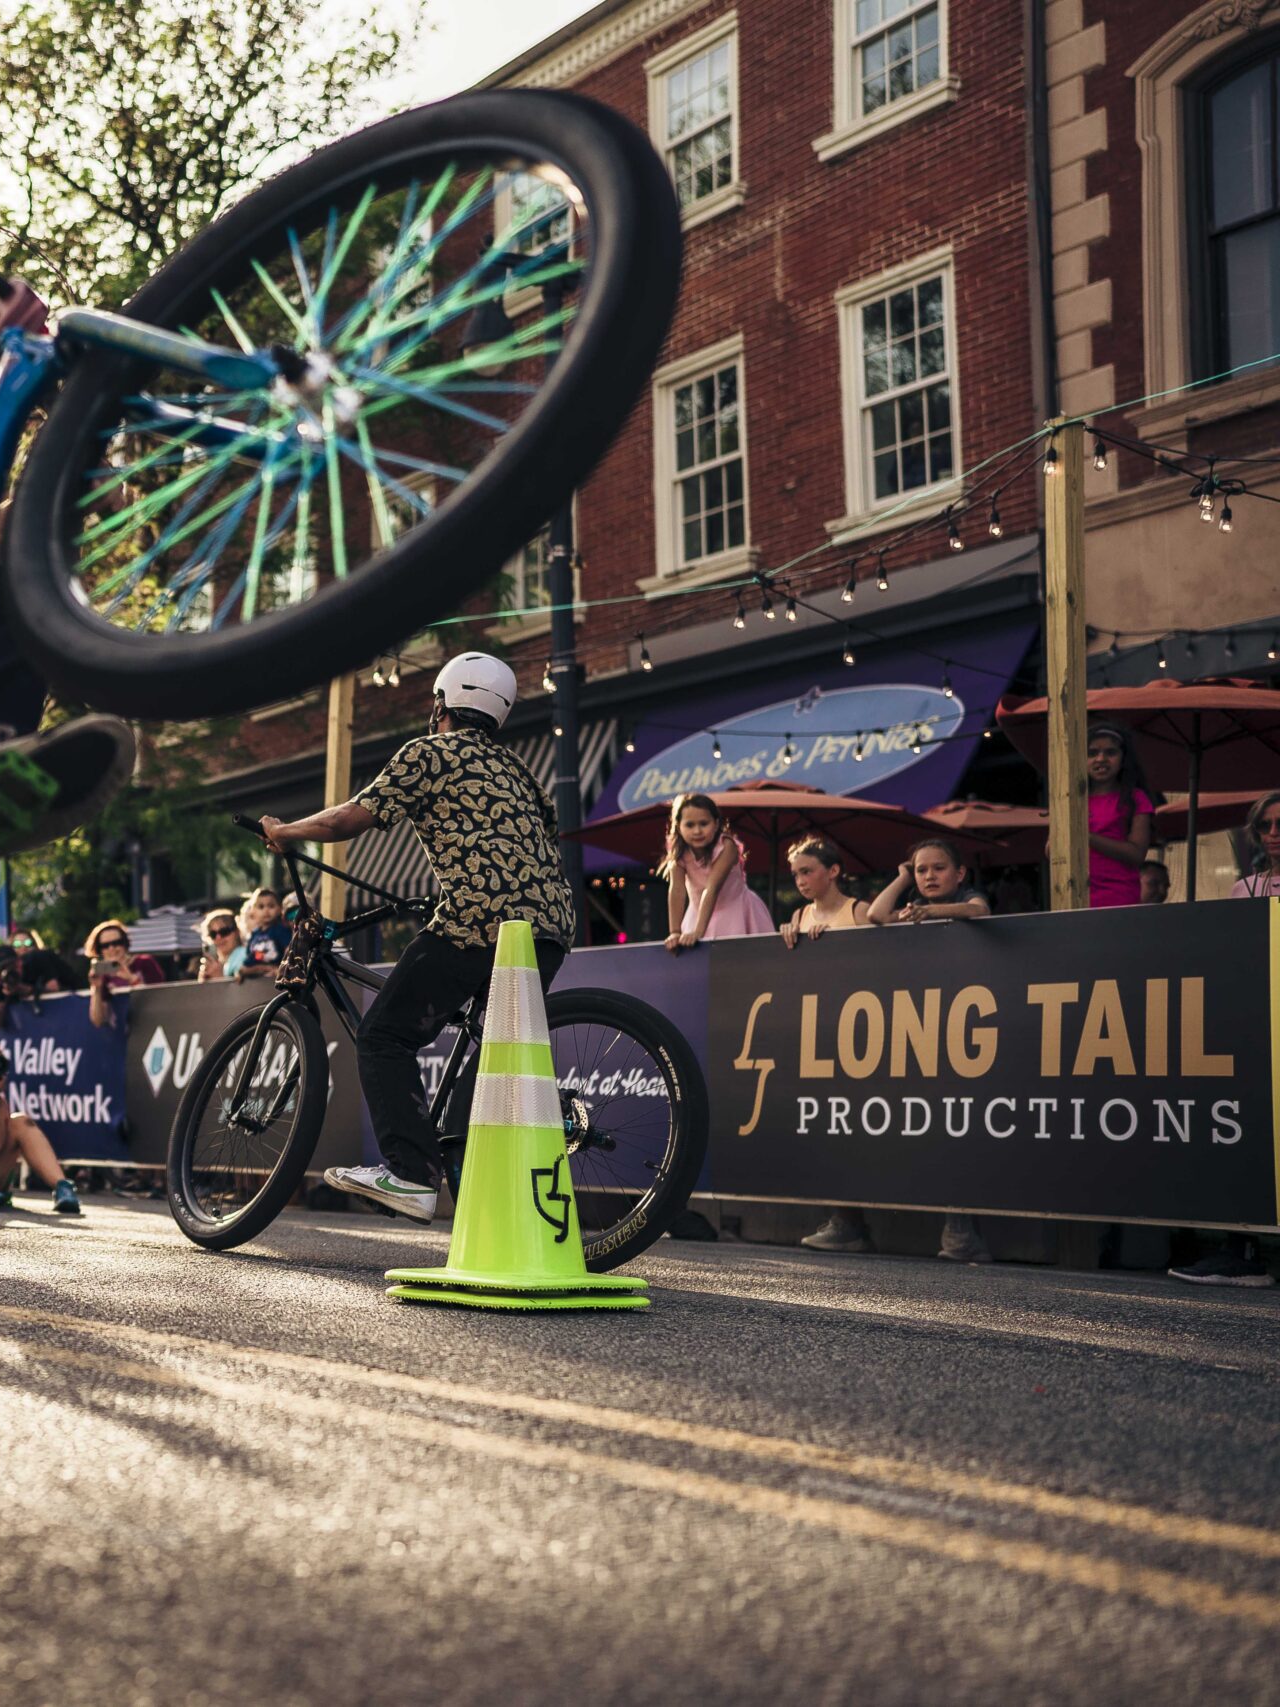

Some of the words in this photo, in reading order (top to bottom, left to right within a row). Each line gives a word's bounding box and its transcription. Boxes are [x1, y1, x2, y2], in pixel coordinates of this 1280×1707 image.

[766, 742, 803, 778] &
[799, 985, 998, 1079] LONG
[1027, 977, 1234, 1077] TAIL
[13, 1037, 82, 1085] Valley
[599, 1069, 622, 1096] at
[8, 1082, 111, 1123] Network
[797, 1097, 1243, 1145] PRODUCTIONS
